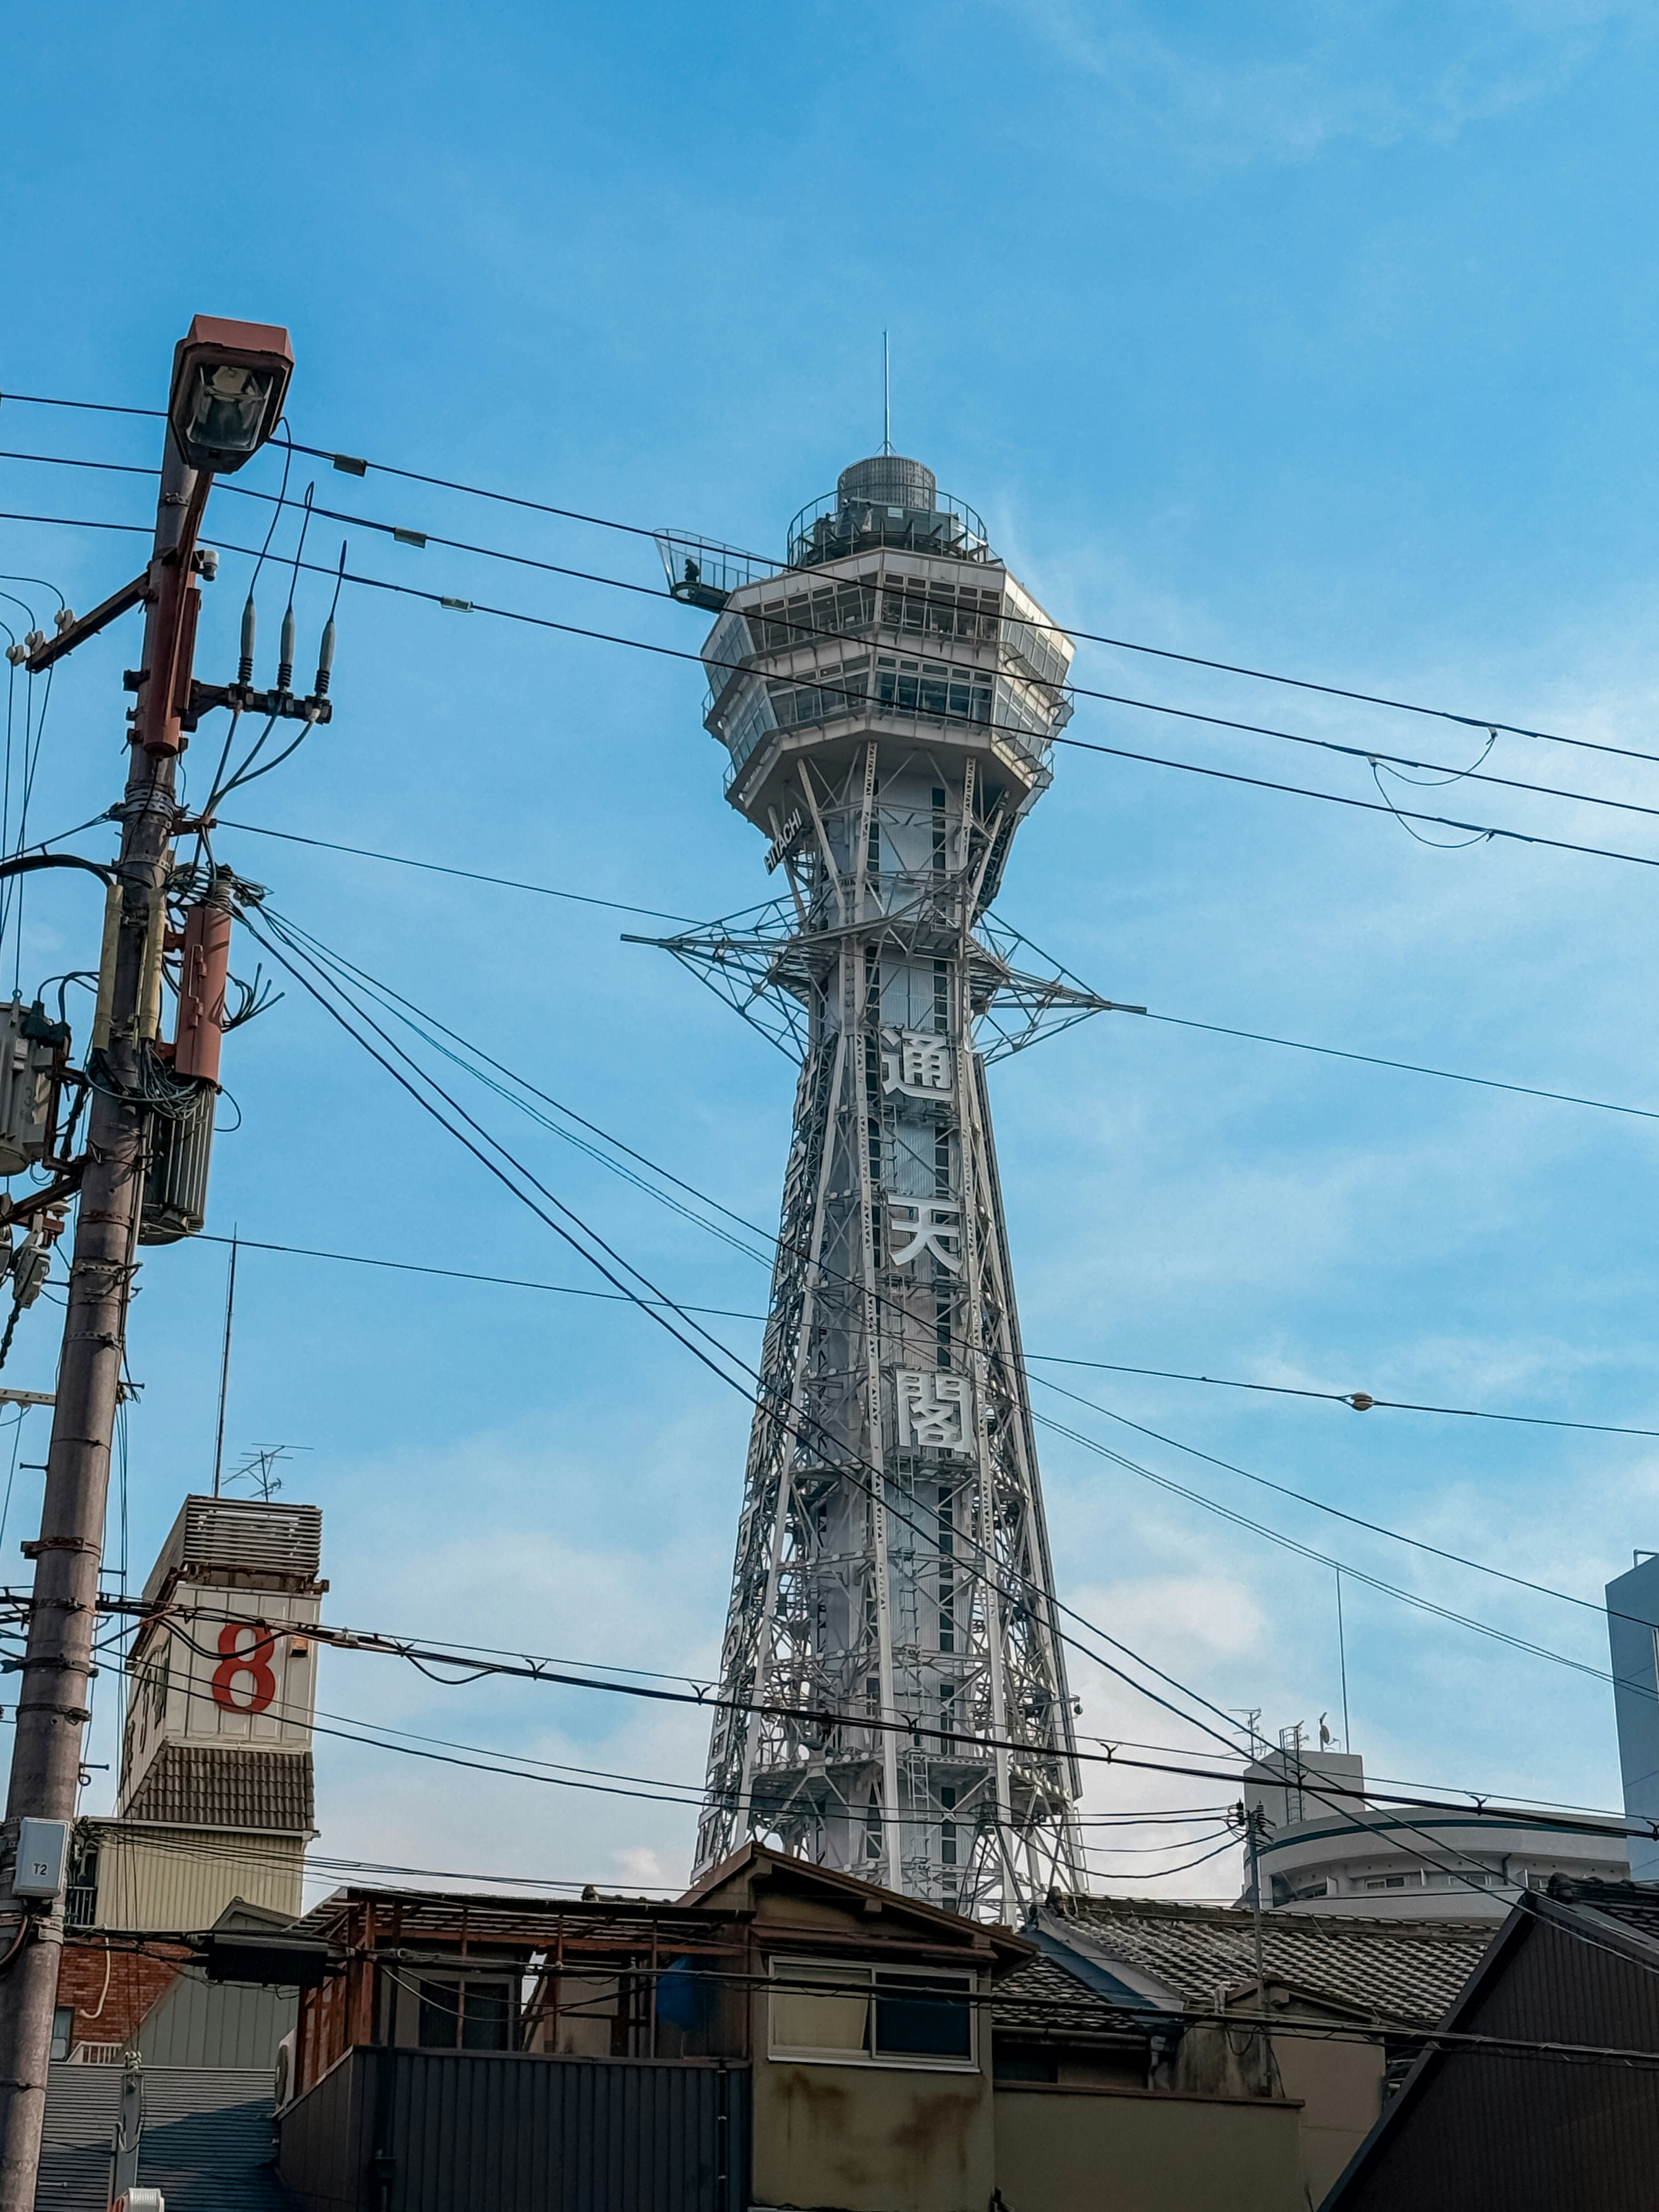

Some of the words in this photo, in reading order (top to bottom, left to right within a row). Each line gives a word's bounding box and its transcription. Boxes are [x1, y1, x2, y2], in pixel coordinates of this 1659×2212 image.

[764, 808, 802, 875] HITACHI
[881, 1028, 973, 1453] 通天閣
[212, 1623, 276, 1714] 8
[33, 1862, 47, 1876] T2
